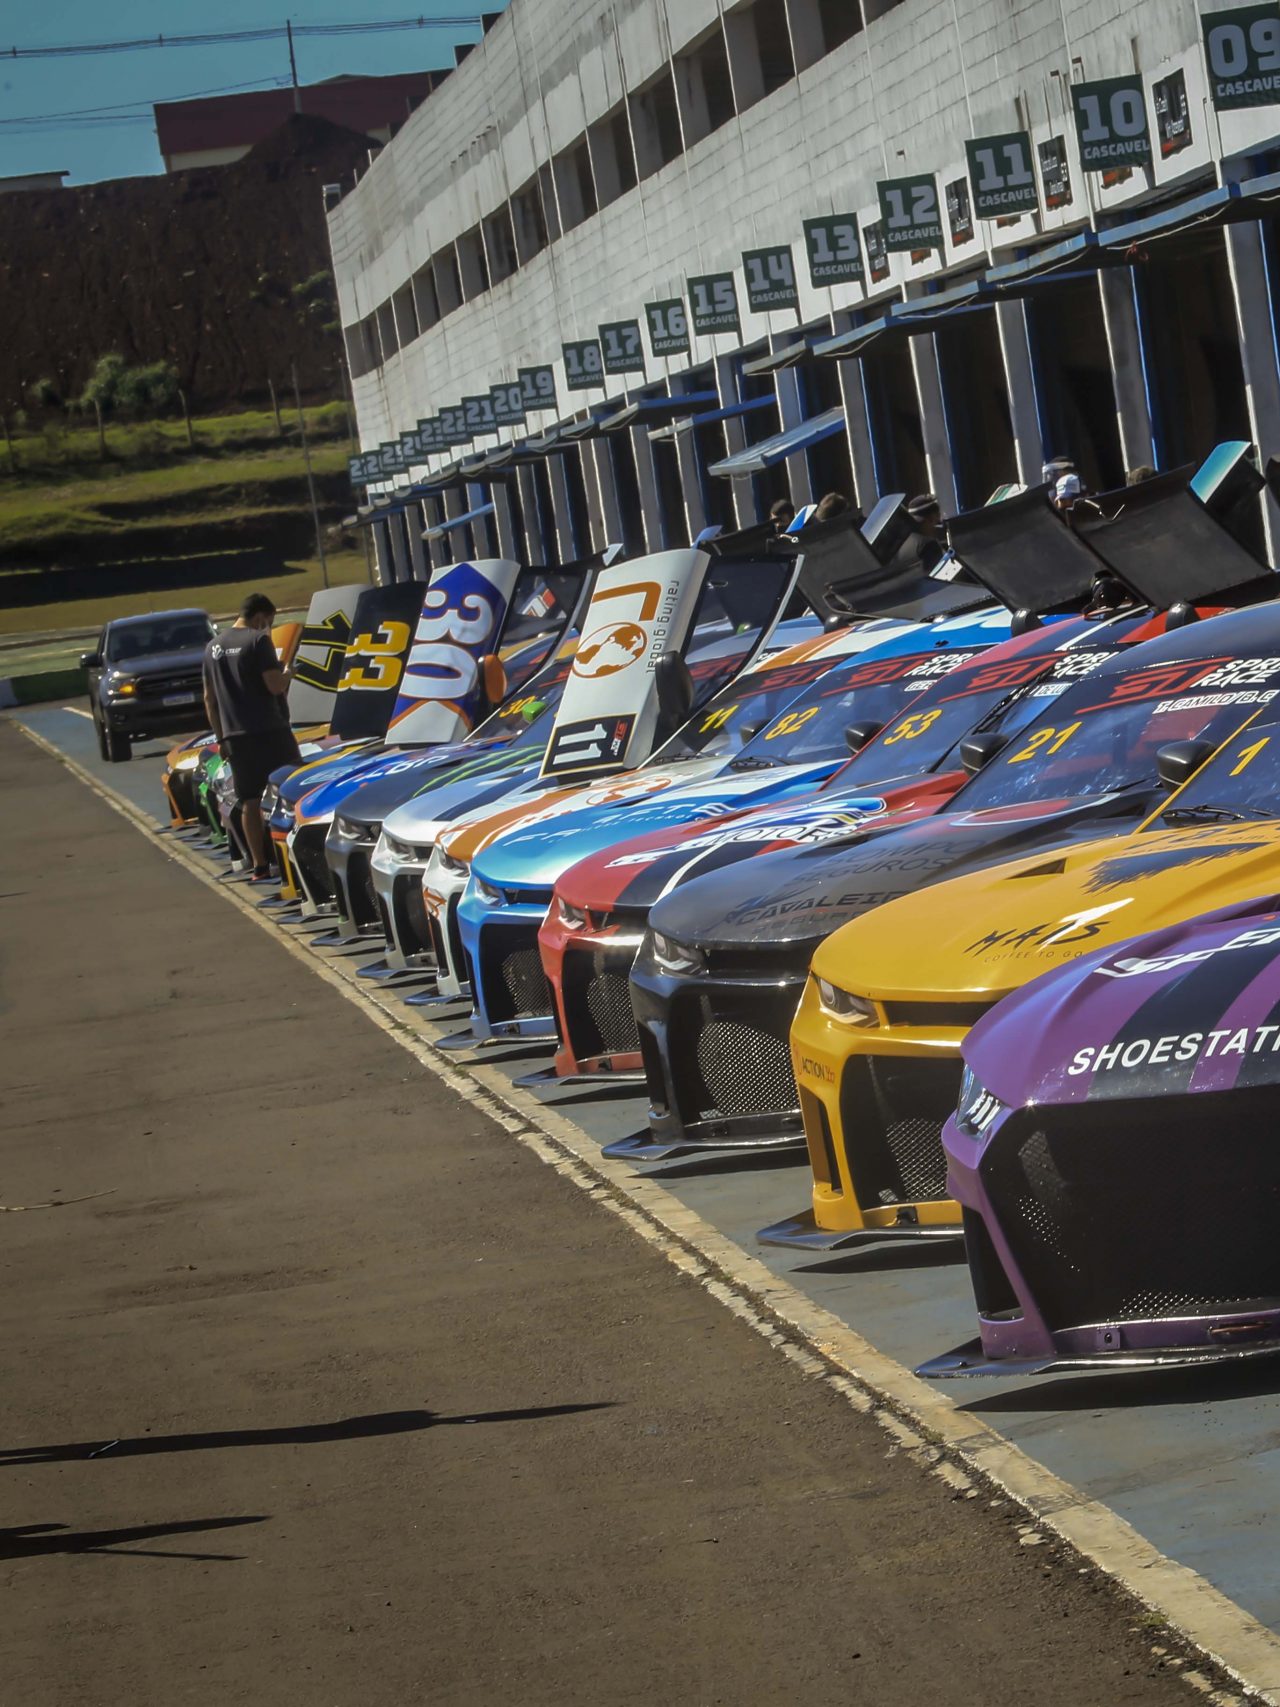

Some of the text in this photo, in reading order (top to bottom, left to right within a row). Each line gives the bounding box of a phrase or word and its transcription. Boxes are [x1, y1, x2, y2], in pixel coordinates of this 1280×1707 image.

[1079, 89, 1146, 142] 10
[1083, 139, 1150, 160] CASCAVEL
[975, 143, 1034, 191] 11
[885, 185, 939, 228] 12
[978, 187, 1037, 207] CASCAVEL
[811, 224, 859, 263] 13
[888, 226, 942, 243] CASCAVEL
[747, 254, 793, 291] 14
[813, 260, 863, 276] CASCAVEL
[693, 281, 737, 316] 15
[751, 289, 797, 304] CASCAVEL
[650, 306, 686, 338] 16
[696, 313, 739, 327] CASCAVEL
[604, 326, 640, 358] 17
[654, 337, 689, 349] CASCAVEL
[565, 345, 601, 375] 18
[606, 355, 643, 368] CASCAVEL
[521, 371, 554, 398] 19
[568, 372, 604, 384] CASCAVEL
[466, 400, 495, 424] 21
[494, 387, 523, 413] 20
[337, 621, 411, 691] 33
[400, 589, 493, 699] 30
[1190, 669, 1280, 688] RACE
[699, 705, 740, 733] 11
[764, 707, 820, 740] 82
[883, 709, 942, 745] 53
[553, 723, 608, 766] 11
[1008, 721, 1082, 764] 21
[1229, 737, 1270, 776] 1
[1038, 951, 1054, 959] TO
